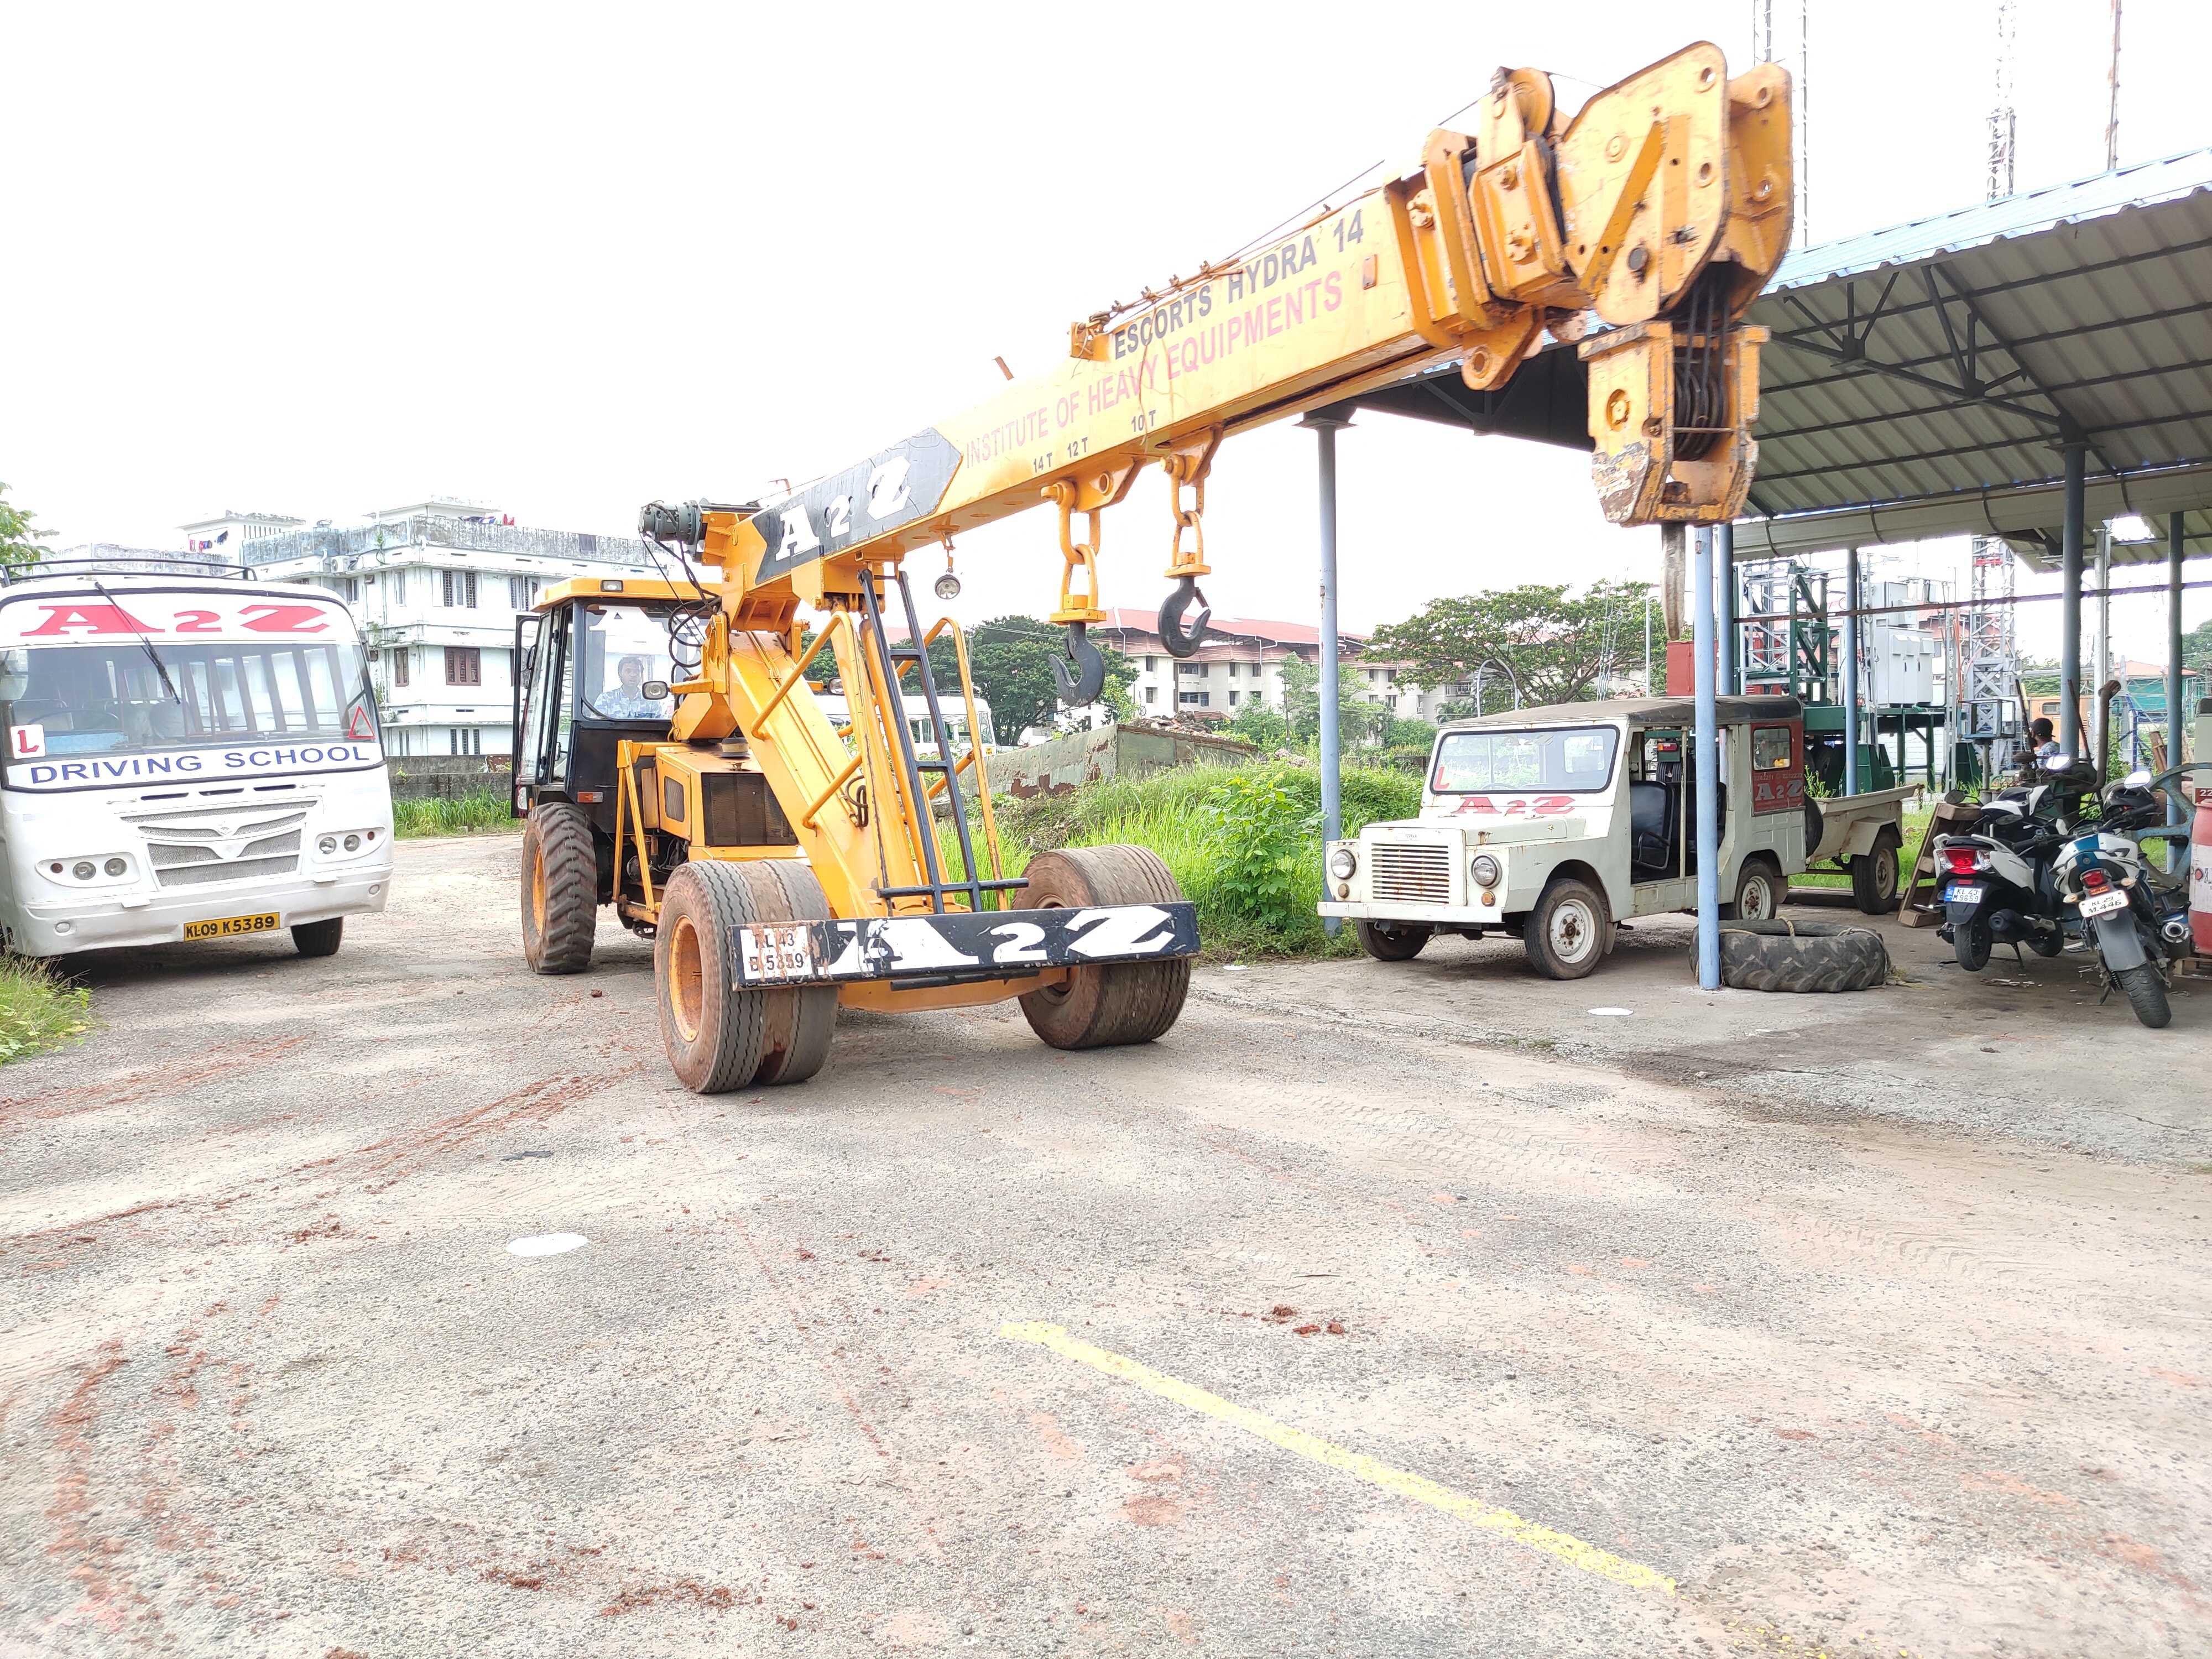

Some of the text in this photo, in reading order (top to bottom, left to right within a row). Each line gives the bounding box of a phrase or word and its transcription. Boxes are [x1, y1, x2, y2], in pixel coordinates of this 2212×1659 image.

[1115, 209, 1364, 360] ESCORTS HYDRA 14
[967, 270, 1343, 468] INSTITUTE OF HEAVY EQUIPMENTS
[1131, 410, 1156, 432] 10 T
[1068, 437, 1088, 458] 12 T
[1033, 452, 1052, 473] 14 T
[18, 729, 40, 754] L
[31, 746, 369, 784] DRIVING SCHOOL
[1433, 766, 1450, 790] L
